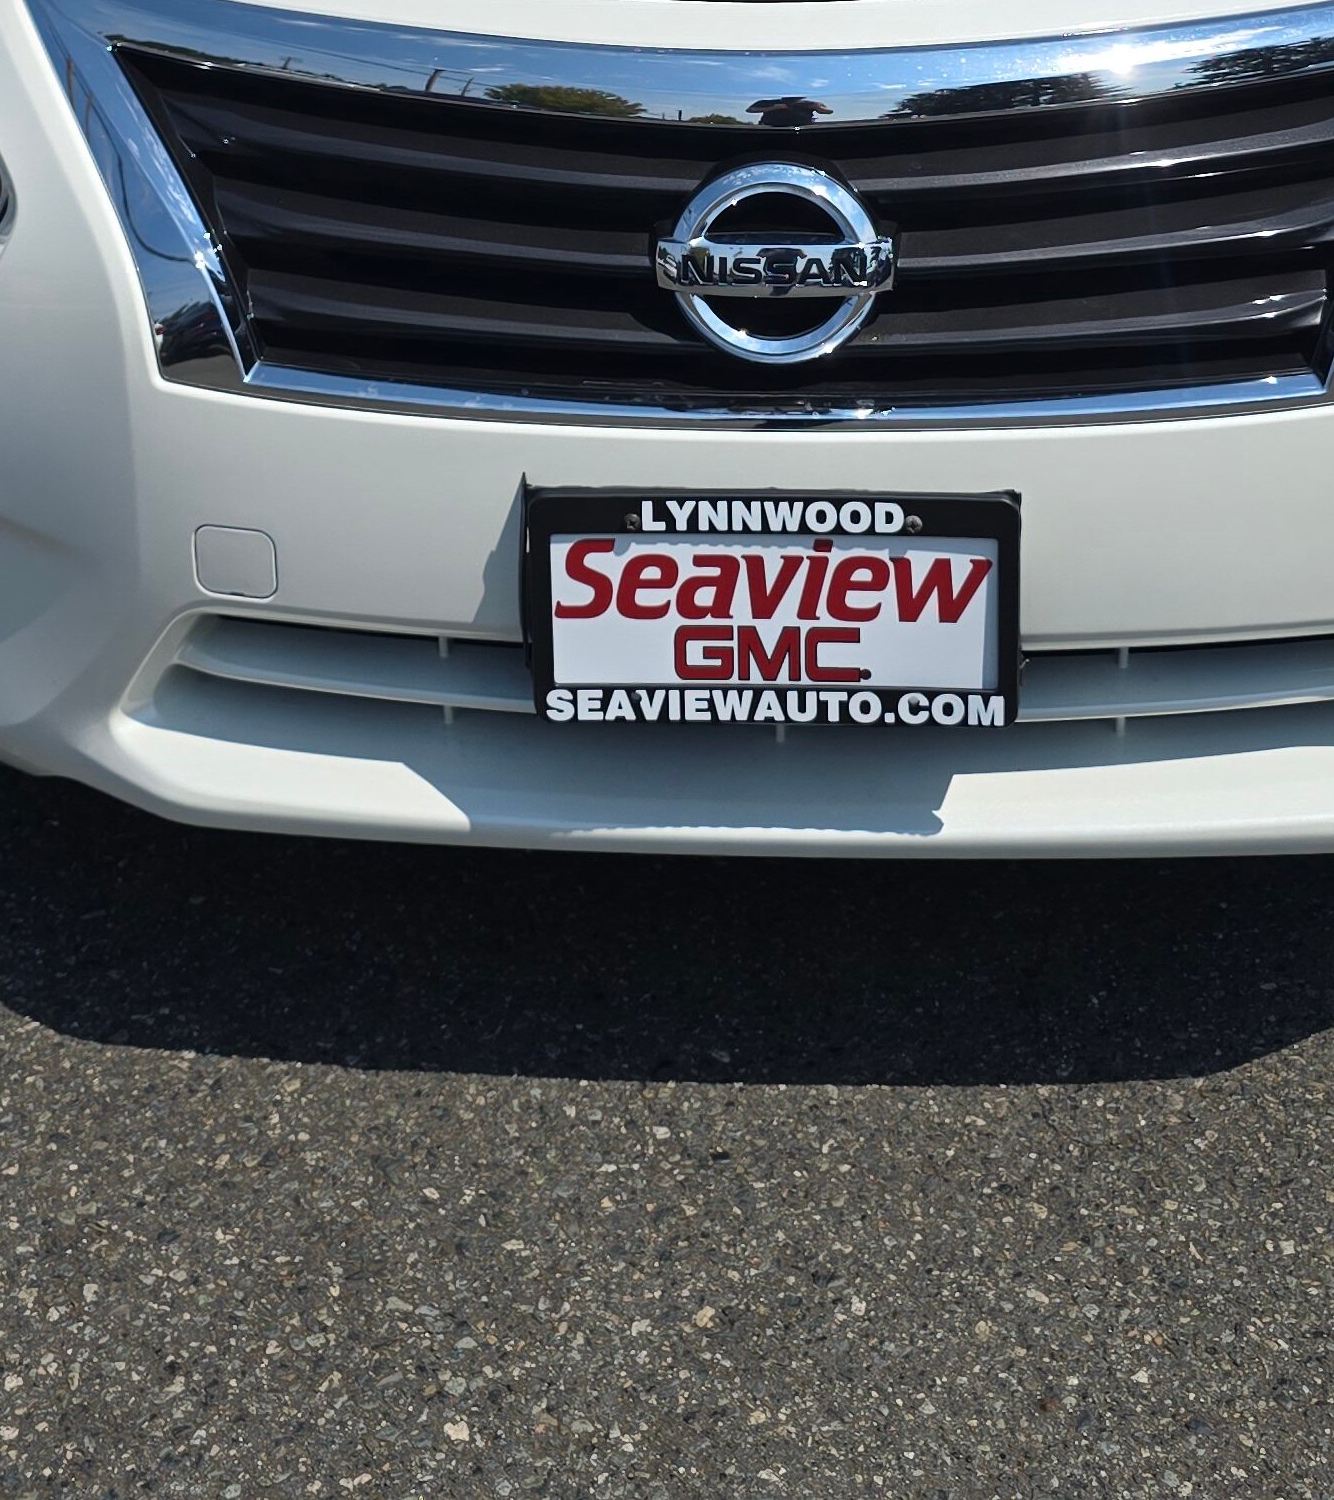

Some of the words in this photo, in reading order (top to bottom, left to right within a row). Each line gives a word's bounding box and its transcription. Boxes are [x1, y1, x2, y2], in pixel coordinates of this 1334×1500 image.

[679, 253, 868, 287] NISSAN
[640, 500, 906, 534] LYNNWOOD
[554, 537, 993, 624] Seaview
[674, 624, 863, 683] GMC
[545, 688, 1005, 727] SEAVIEWAUTO.COM
